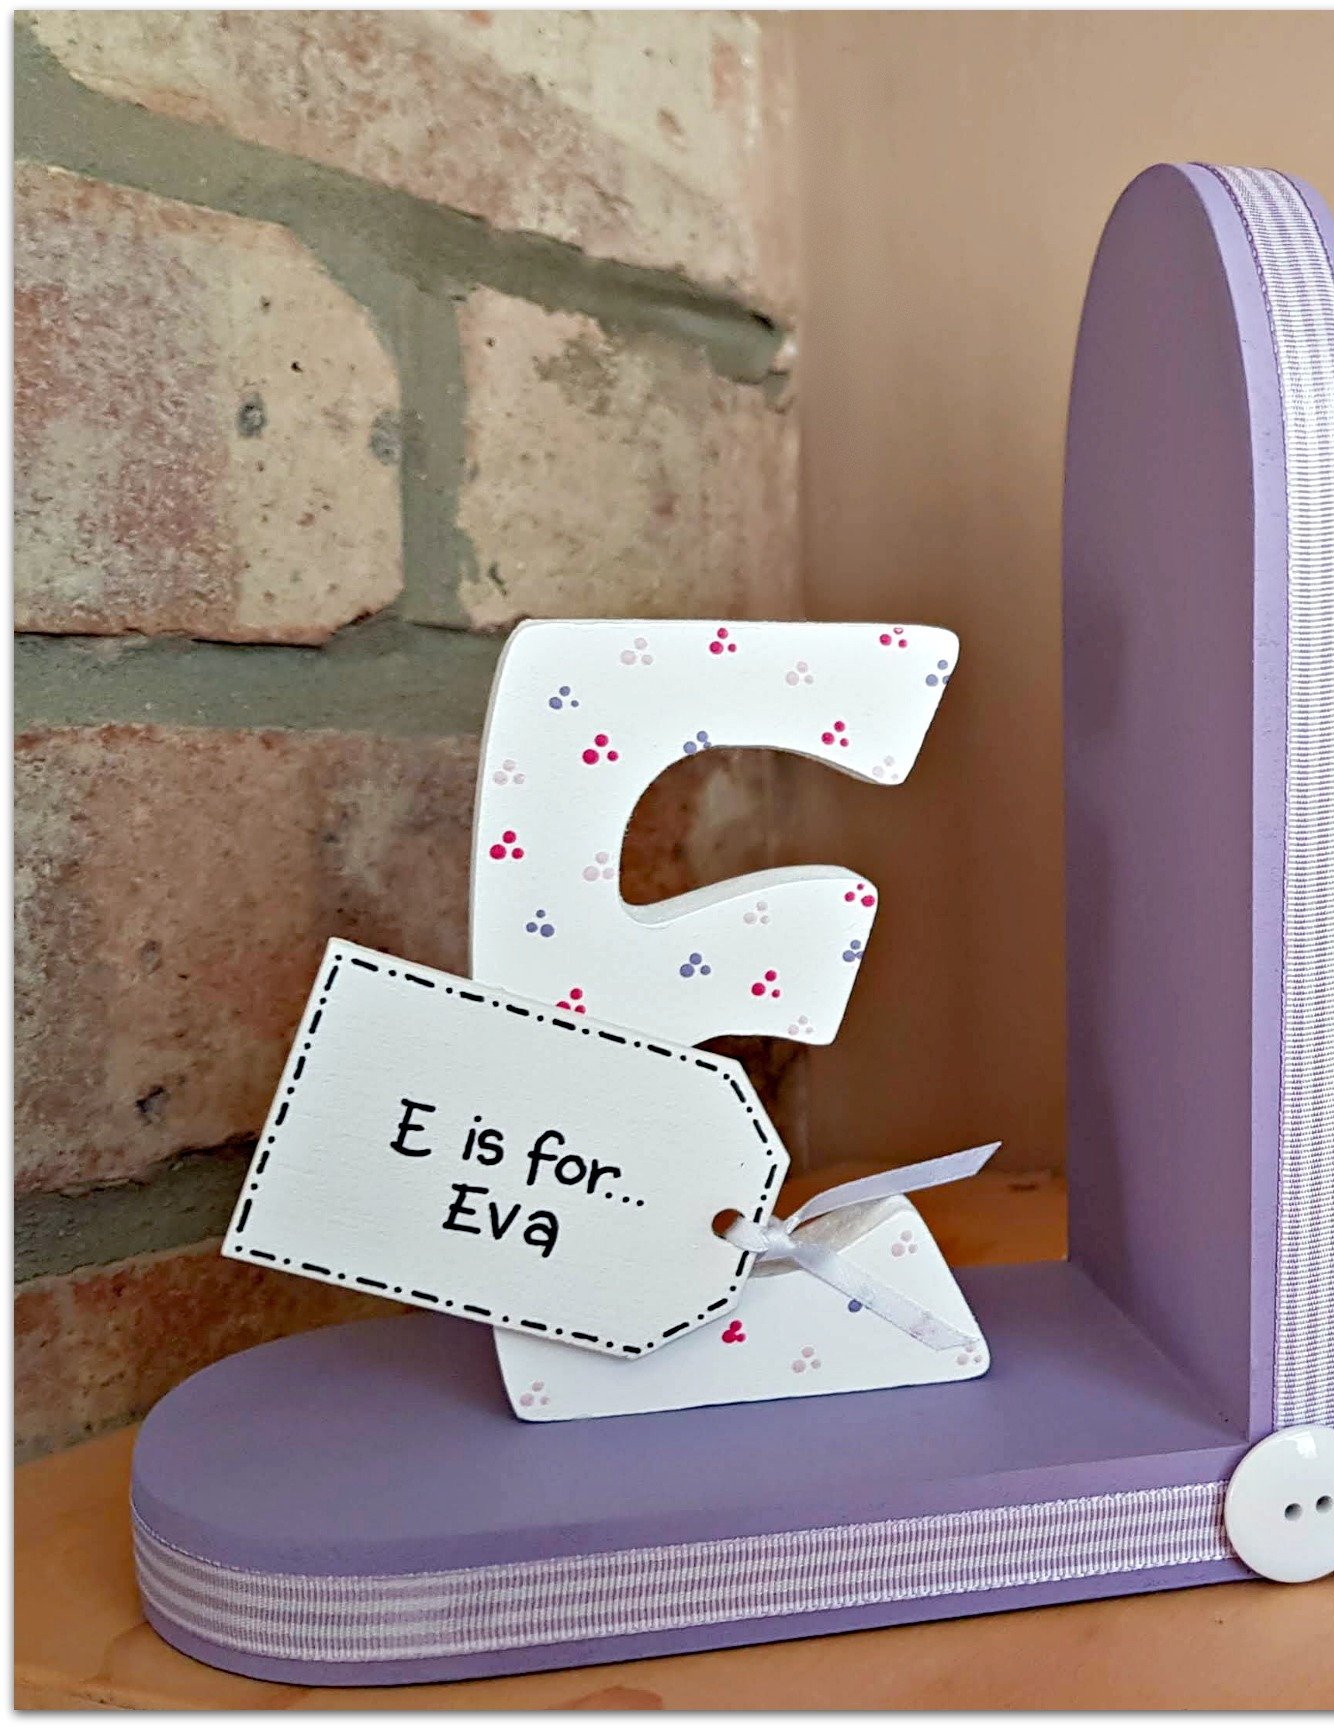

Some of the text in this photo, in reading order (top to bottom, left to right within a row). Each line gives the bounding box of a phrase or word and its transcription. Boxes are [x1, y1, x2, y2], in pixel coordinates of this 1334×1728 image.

[468, 618, 992, 1422] E
[389, 1098, 645, 1207] E is for...
[442, 1183, 559, 1259] Eva
